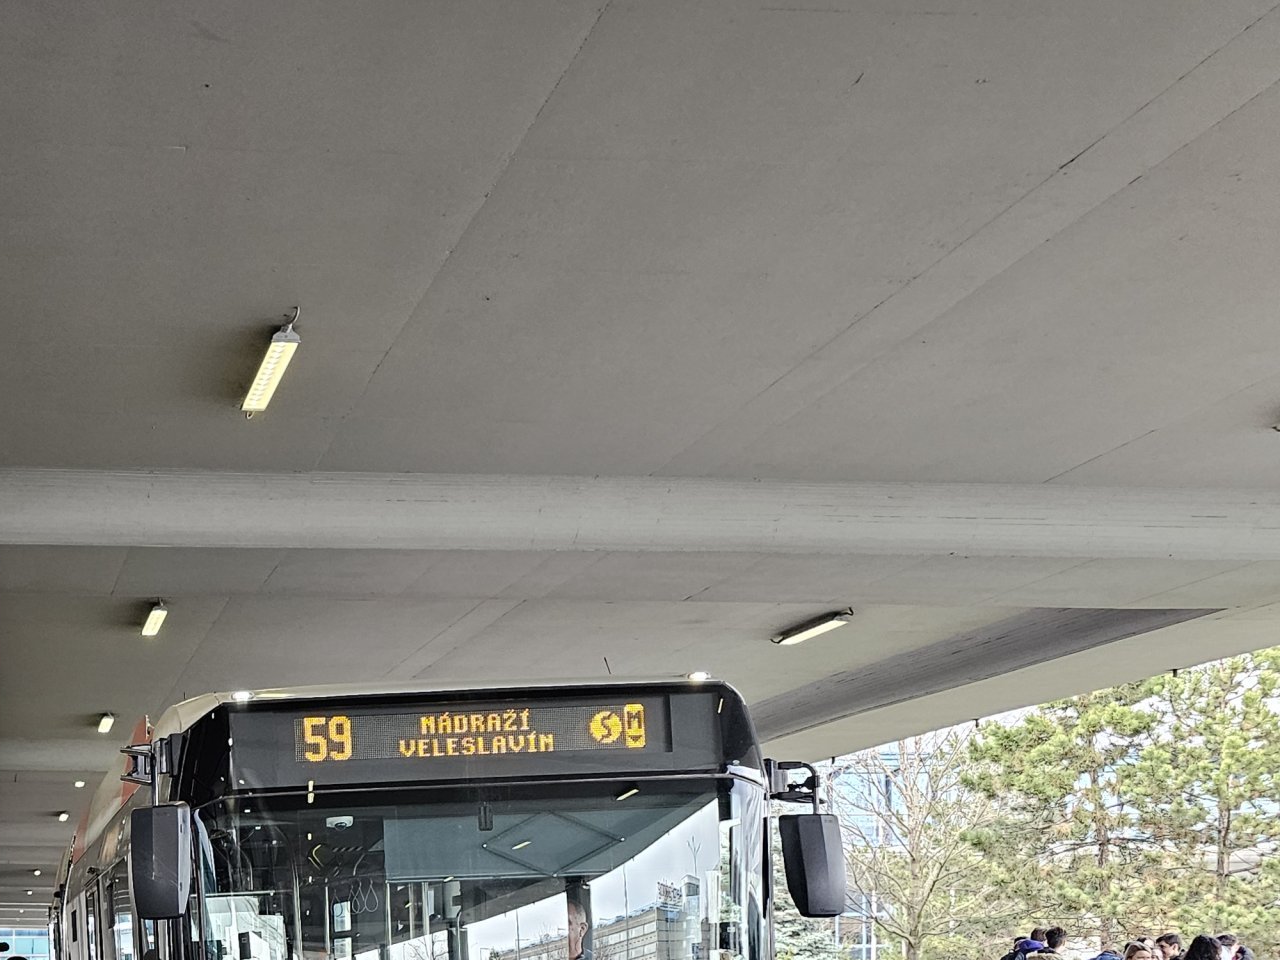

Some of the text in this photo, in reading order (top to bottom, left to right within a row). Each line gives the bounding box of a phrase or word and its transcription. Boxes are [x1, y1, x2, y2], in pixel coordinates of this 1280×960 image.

[420, 708, 531, 734] NÁDRAŽÍ
[303, 715, 353, 762] 59
[399, 730, 555, 758] VELESLAVÍN
